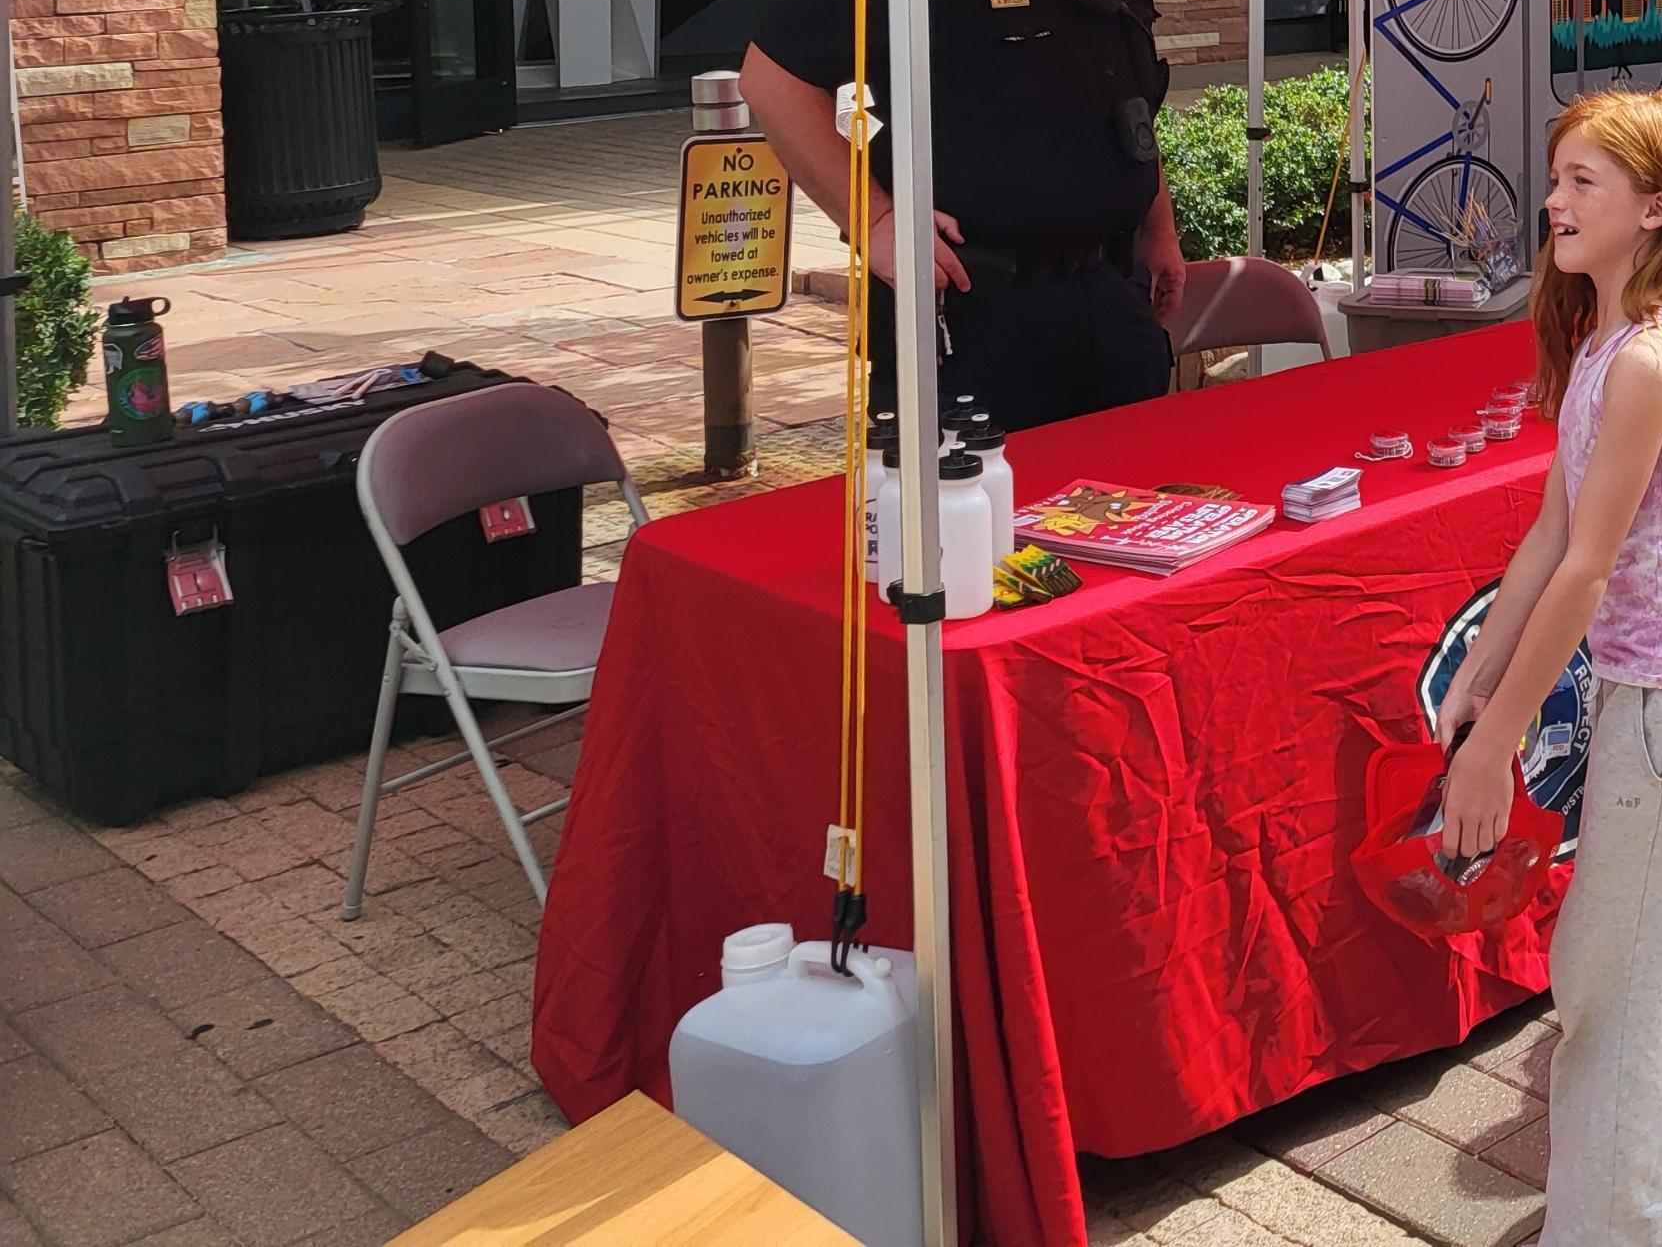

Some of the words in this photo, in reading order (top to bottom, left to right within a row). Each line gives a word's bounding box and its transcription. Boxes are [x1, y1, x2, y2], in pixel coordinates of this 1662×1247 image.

[723, 153, 755, 172] NO
[692, 178, 781, 201] PARKING
[701, 207, 771, 225] Unauthorized
[694, 229, 739, 245] vehicles
[741, 227, 759, 241] will
[761, 225, 776, 240] be
[711, 247, 745, 263] towed
[747, 247, 758, 260] at
[687, 269, 728, 285] owner's
[731, 265, 779, 283] expense.
